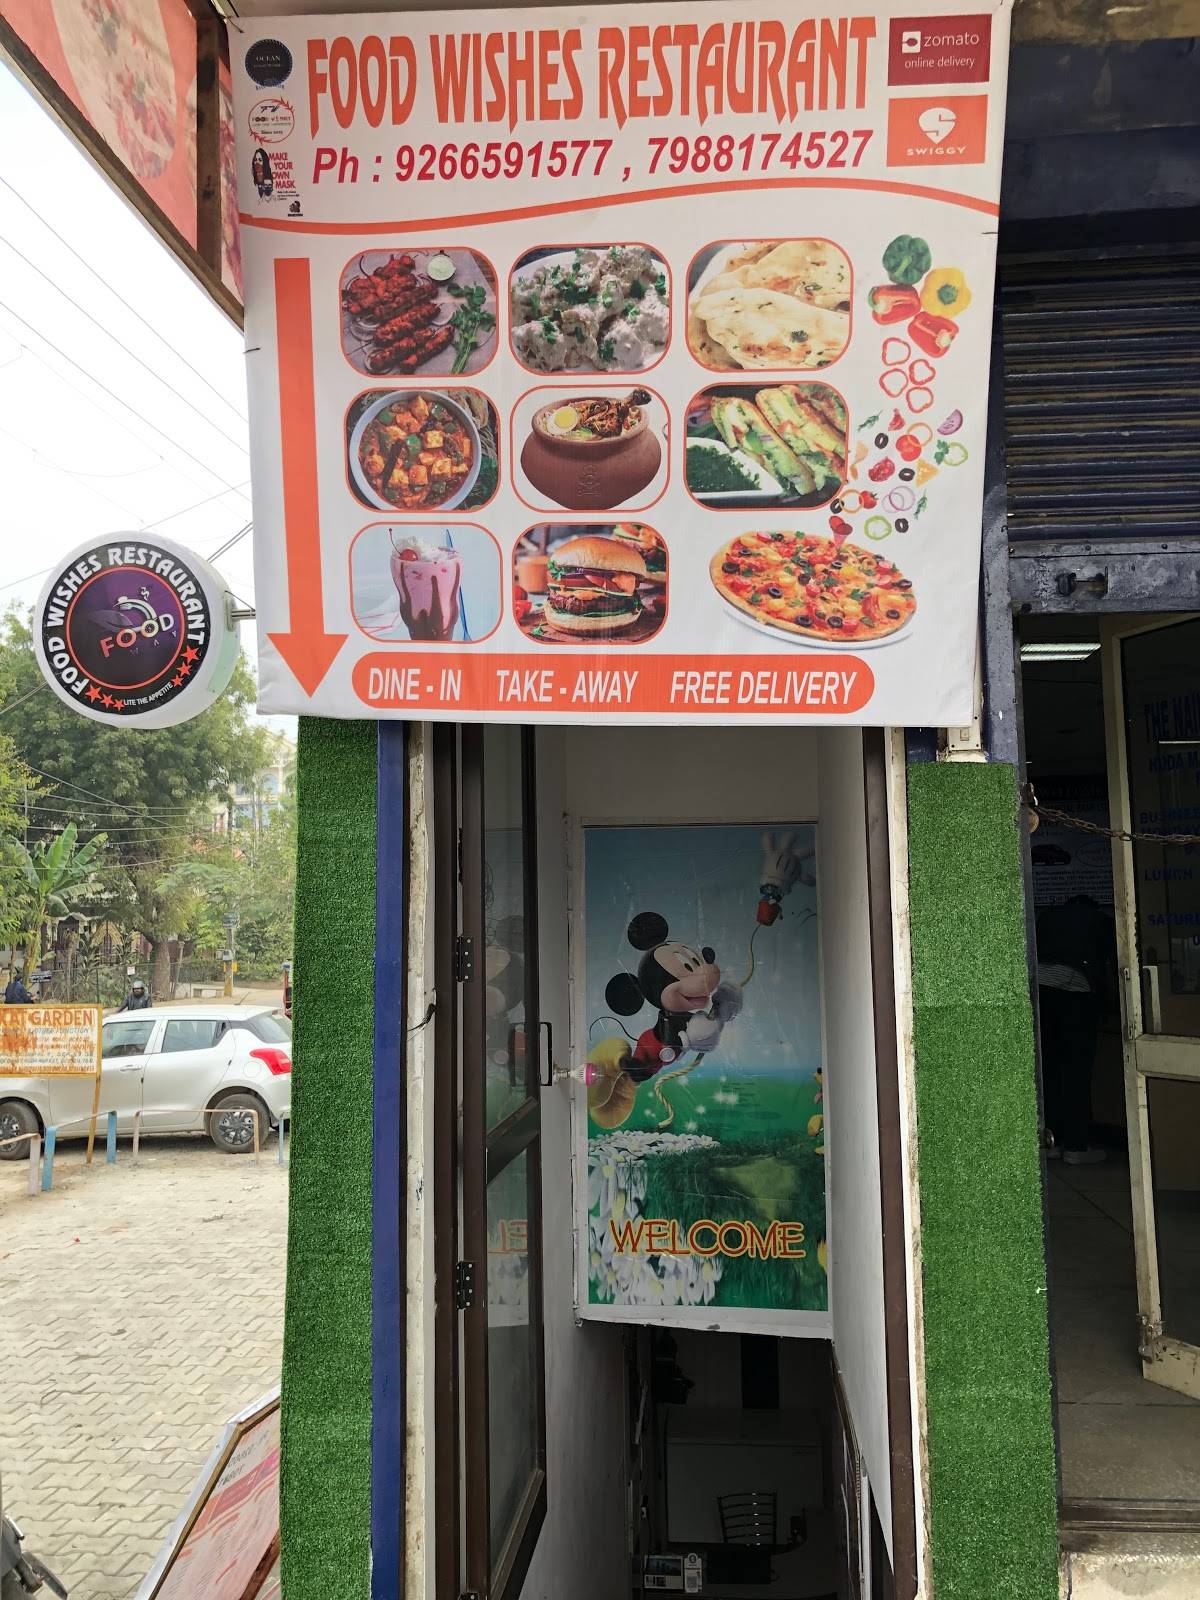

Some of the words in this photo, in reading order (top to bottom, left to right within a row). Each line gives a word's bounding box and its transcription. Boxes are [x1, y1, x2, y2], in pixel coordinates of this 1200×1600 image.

[924, 31, 980, 47] zomato
[904, 57, 935, 69] online
[937, 55, 976, 69] delivery
[307, 35, 417, 140] FOOD
[429, 29, 584, 135] WISHES
[598, 16, 877, 130] RESTAURANT
[268, 152, 288, 161] MAKE
[312, 147, 359, 184] Ph
[372, 155, 383, 183] :
[395, 138, 613, 182] 9266591577
[647, 129, 874, 174] 7988174527
[906, 145, 966, 157] SWIGGY
[272, 171, 290, 180] OWN
[273, 161, 293, 170] YOUR
[275, 180, 296, 189] MASK
[46, 553, 103, 628] WISHES
[107, 546, 206, 645] RESTAURANT
[47, 636, 90, 695] FOOD
[136, 696, 149, 705] THE
[148, 682, 174, 702] APPETITE
[368, 667, 420, 700] DINE
[439, 669, 462, 701] IN
[496, 669, 554, 702] TAKE
[572, 670, 639, 703] AWAY
[669, 670, 732, 704] FREE
[736, 671, 858, 705] DELIVERY
[1144, 699, 1170, 739] THE
[1144, 868, 1193, 882] LUNCH
[30, 1010, 93, 1026] GARDEN
[610, 1218, 806, 1259] WELCOME
